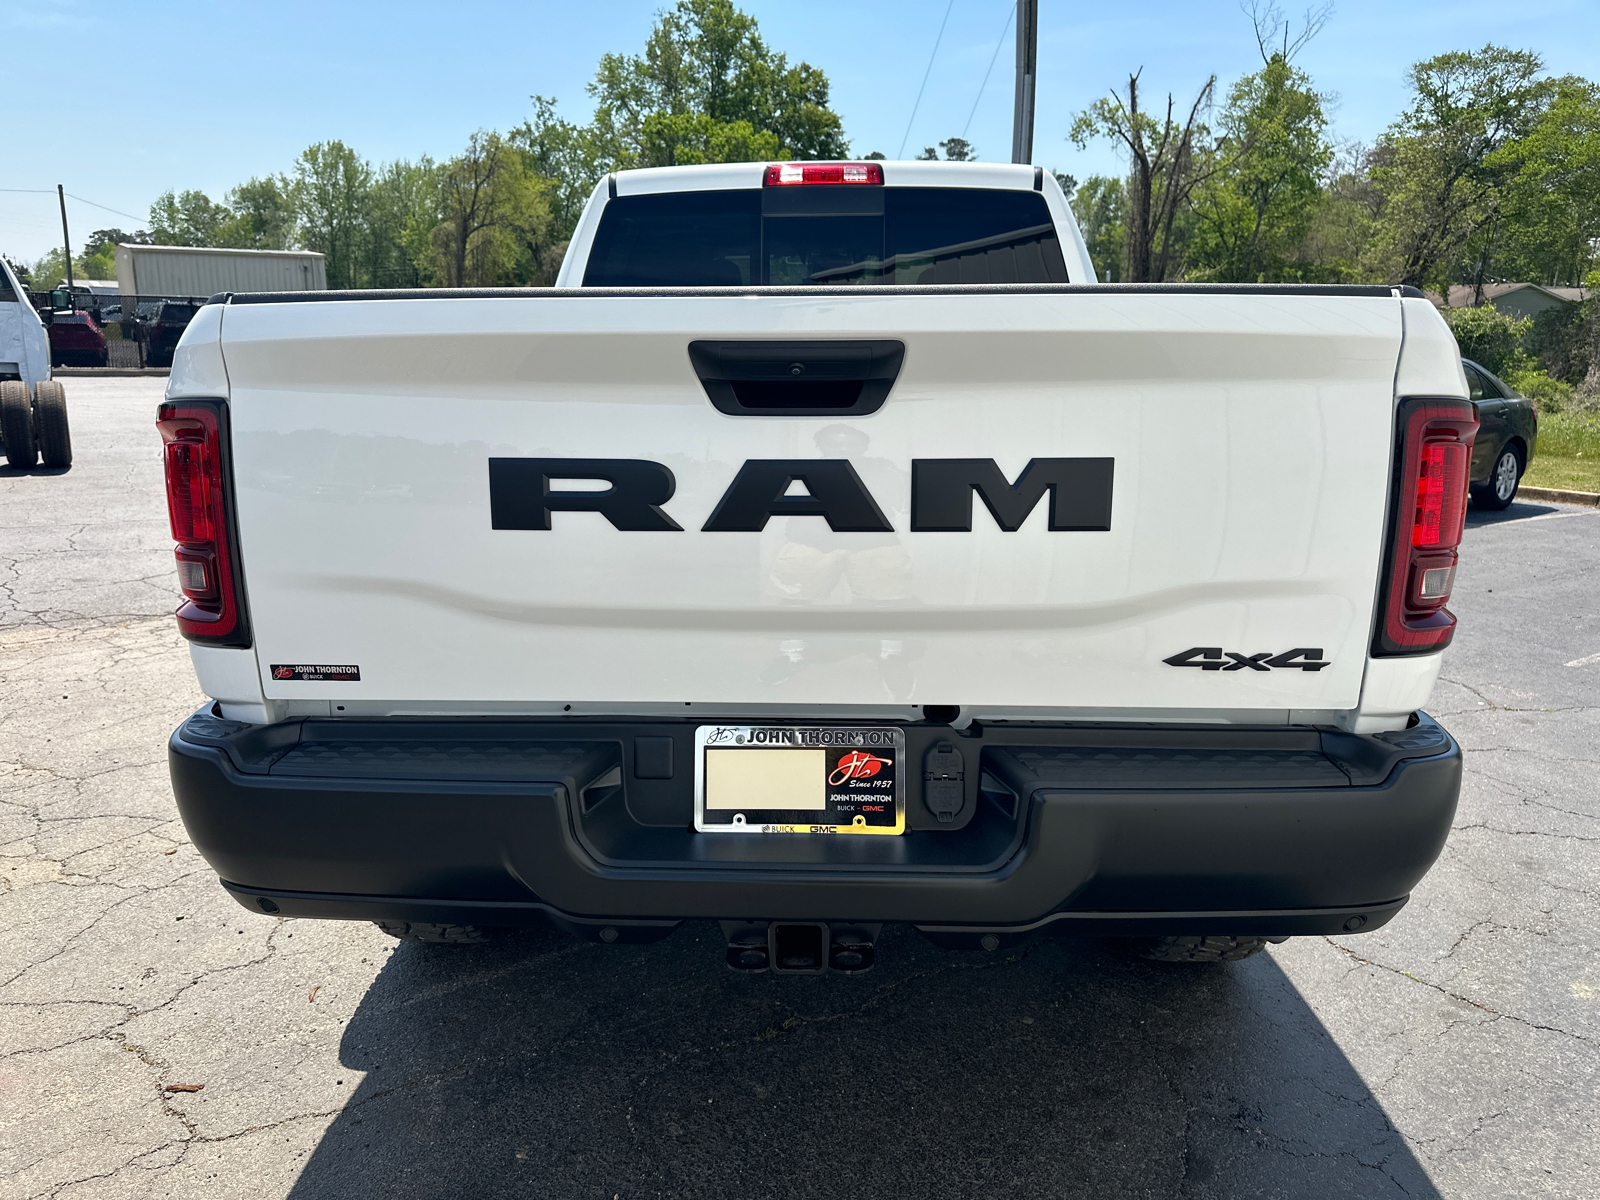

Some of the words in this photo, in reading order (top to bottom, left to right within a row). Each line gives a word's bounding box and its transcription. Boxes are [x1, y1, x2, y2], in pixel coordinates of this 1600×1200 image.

[489, 457, 1115, 532] RAM
[1162, 647, 1331, 671] 4x4
[316, 666, 357, 674] THORNTON
[747, 731, 793, 743] JOHN
[799, 731, 894, 744] THORNTON
[830, 794, 849, 802] JOHN
[850, 794, 892, 802] THORNTON
[771, 825, 795, 833] BUICK
[810, 825, 837, 833] GMC
